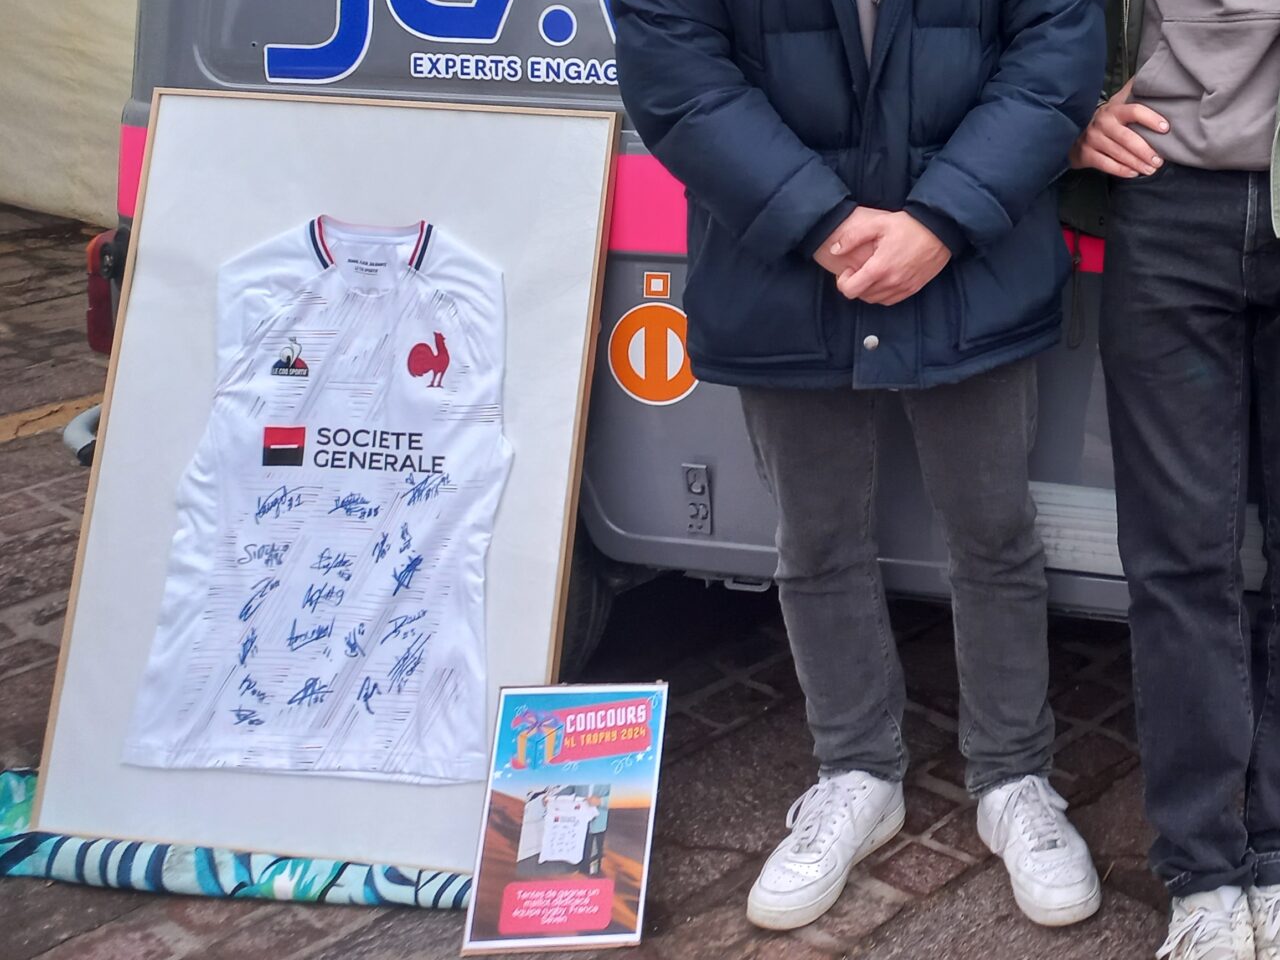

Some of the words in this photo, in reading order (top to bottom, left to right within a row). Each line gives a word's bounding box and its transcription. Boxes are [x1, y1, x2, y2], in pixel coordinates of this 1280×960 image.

[412, 56, 520, 80] EXPERTS
[315, 427, 424, 451] SOCIETE
[313, 449, 446, 474] GENERALE
[565, 704, 647, 734] CONCOURS
[564, 736, 577, 749] 4L
[580, 730, 618, 747] TROPHY
[621, 726, 647, 741] 2024
